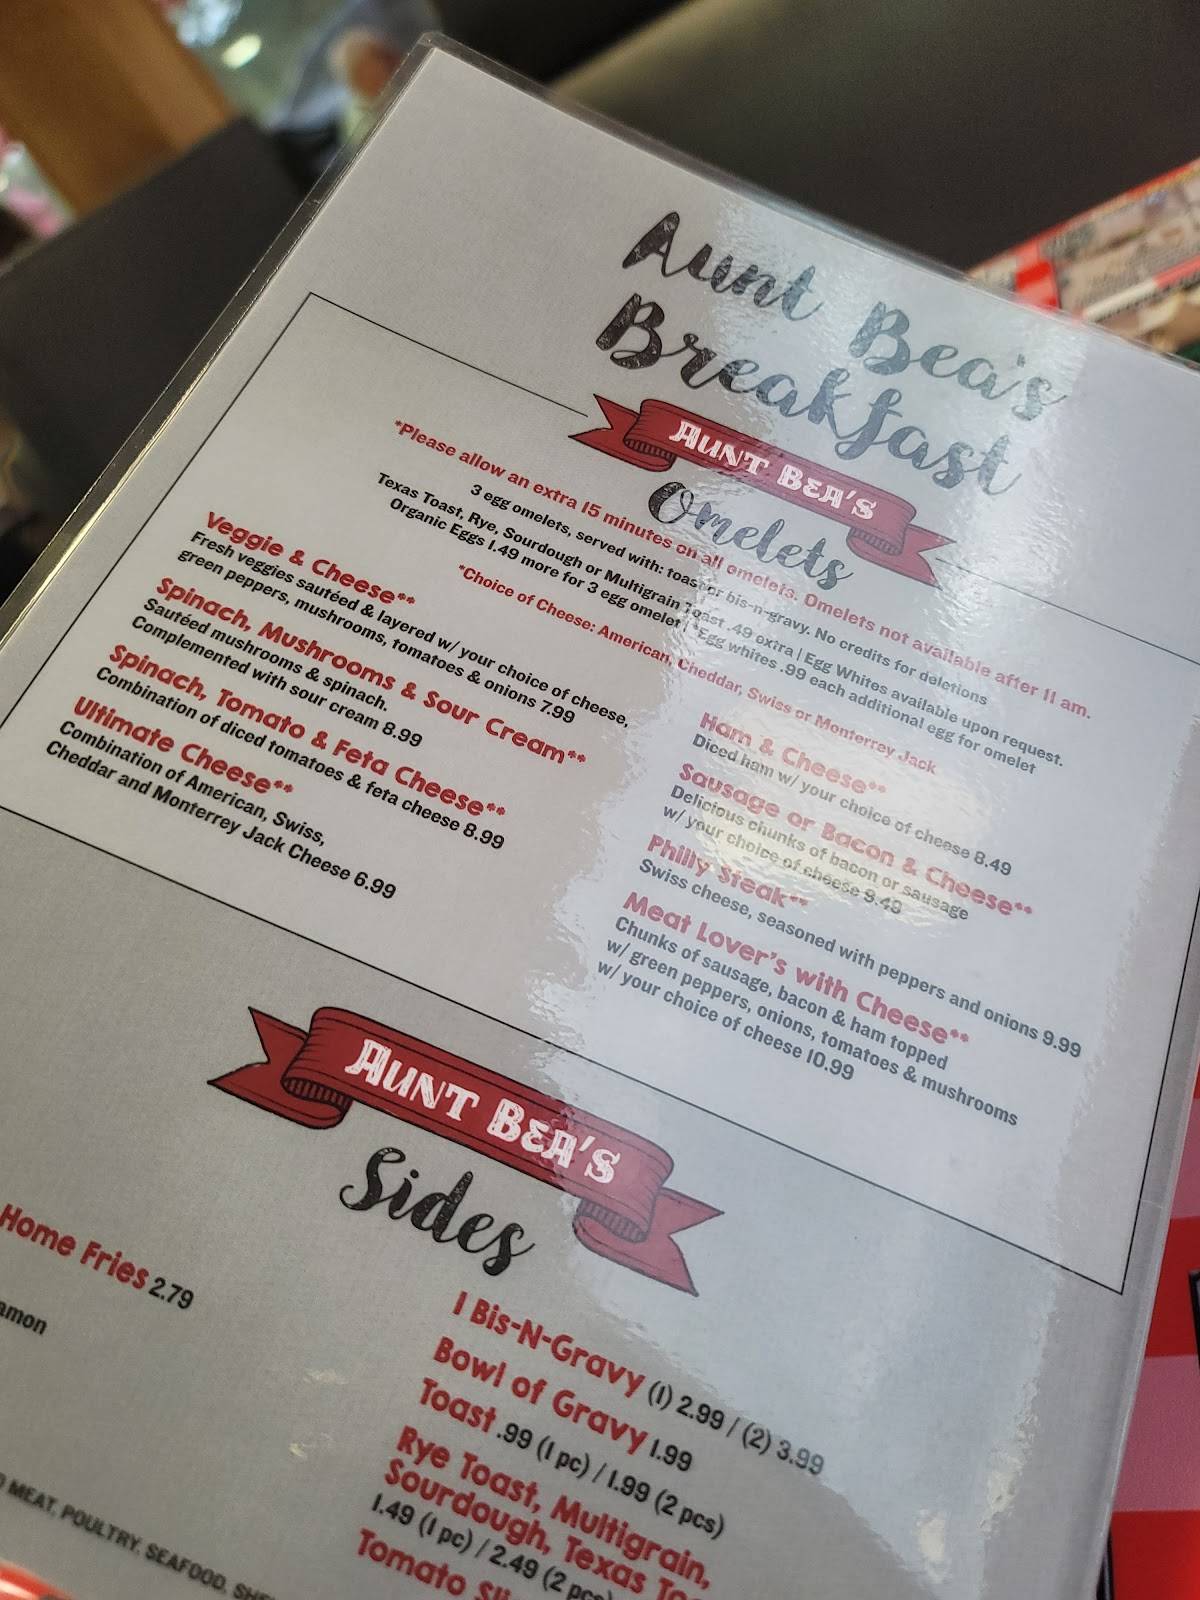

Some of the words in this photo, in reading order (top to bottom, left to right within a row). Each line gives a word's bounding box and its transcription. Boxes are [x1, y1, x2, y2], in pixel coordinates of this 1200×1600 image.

[622, 211, 825, 322] Aunt
[848, 301, 1067, 422] Bea's
[595, 293, 1023, 496] Breakfast
[668, 419, 770, 477] AUNT
[206, 511, 284, 557] Veggie
[458, 451, 506, 477] allow
[506, 472, 530, 489] an
[532, 483, 577, 510] extra
[602, 512, 673, 549] minutes
[803, 592, 876, 631] Omelets
[994, 672, 1038, 696] after
[469, 483, 483, 496] 3
[482, 492, 512, 511] egg
[511, 504, 571, 537] omelets,
[575, 531, 627, 558] served
[627, 552, 664, 574] with:
[647, 481, 853, 591] Omelets
[131, 615, 251, 674] Complemented
[251, 667, 287, 691] with
[288, 684, 328, 706] sour
[328, 701, 379, 730] cream
[381, 721, 423, 747] 8.99
[143, 597, 211, 634] Sautéed
[209, 628, 303, 674] mushrooms
[322, 676, 387, 712] spinach.
[155, 577, 251, 632] Spinach,
[256, 621, 396, 690] Mushrooms
[422, 690, 480, 725] Sour
[176, 549, 224, 575] green
[222, 569, 290, 605] peppers,
[293, 598, 387, 647] mushrooms,
[391, 638, 464, 677] tomatoes
[483, 679, 537, 708] onions
[539, 699, 575, 723] 7.99
[190, 530, 235, 558] Fresh
[237, 552, 295, 583] veggies
[295, 578, 360, 611] sautéed
[376, 609, 436, 643] layered
[457, 647, 496, 668] your
[497, 663, 549, 691] choice
[550, 686, 571, 700] of
[570, 695, 628, 728] cheese,
[377, 471, 419, 499] Texas
[422, 490, 464, 520] Toast,
[467, 511, 498, 535] Rye,
[502, 526, 583, 569] Sourdough
[584, 564, 603, 576] or
[603, 569, 681, 610] Multigrain
[1002, 734, 1063, 767] request.
[389, 497, 447, 530] Organic
[448, 522, 485, 546] Eggs
[487, 539, 520, 560] 1.49
[520, 555, 559, 577] more
[561, 571, 585, 588] for
[586, 581, 599, 594] 3
[599, 589, 629, 609] egg
[629, 602, 681, 628] omelet
[808, 676, 846, 697] each
[847, 691, 925, 729] additional
[926, 723, 956, 744] egg
[957, 733, 981, 751] for
[516, 592, 536, 605] of
[535, 598, 596, 632] Cheese:
[746, 686, 792, 714] Swiss
[73, 695, 174, 753] Ultimate
[96, 666, 198, 719] Combination
[199, 713, 221, 728] of
[219, 720, 268, 748] diced
[267, 739, 344, 781] tomatoes
[364, 780, 399, 806] feta
[401, 799, 460, 831] cheese
[462, 822, 505, 849] 8.99
[108, 644, 207, 701] Spinach,
[216, 687, 305, 739] Tomato
[331, 738, 390, 776] Feta
[699, 711, 752, 747] Ham
[45, 740, 118, 779] Cheddar
[117, 774, 153, 795] and
[151, 784, 241, 835] Monterrey
[241, 825, 286, 853] Jack
[287, 843, 351, 880] Cheese
[353, 871, 396, 899] 6.99
[59, 720, 163, 775] Combination
[164, 768, 187, 783] of
[183, 774, 267, 822] American,
[272, 811, 324, 847] Swiss,
[678, 762, 780, 818] Sausage
[820, 821, 895, 867] Bacon
[646, 833, 712, 878] Philly
[615, 916, 678, 954] Chunks
[680, 947, 701, 963] of
[701, 956, 772, 997] sausage,
[776, 984, 828, 1019] bacon
[849, 1015, 886, 1044] ham
[889, 1034, 949, 1070] topped
[622, 891, 692, 934] Meat
[795, 966, 849, 1003] with
[638, 858, 688, 889] Swiss
[690, 883, 752, 920] cheese,
[756, 911, 837, 953] seasoned
[839, 945, 875, 970] with
[877, 963, 946, 1000] peppers
[948, 993, 981, 1015] and
[983, 1008, 1039, 1040] onions
[1041, 1029, 1082, 1058] 9.99
[619, 971, 661, 996] your
[662, 990, 718, 1022] choice
[721, 1015, 742, 1032] of
[742, 1024, 803, 1058] cheese
[628, 951, 678, 980] green
[679, 972, 751, 1013] peppers,
[756, 1005, 815, 1041] onions,
[820, 1030, 899, 1075] tomatoes
[921, 1075, 1018, 1126] mushrooms
[345, 1039, 480, 1122] AUNT
[0, 1203, 76, 1257] Home
[79, 1240, 149, 1290] Fries
[147, 1276, 194, 1310] 2.79
[339, 1147, 535, 1277] Sides
[419, 1377, 497, 1433] Toast
[606, 1469, 651, 1503] 1.99
[432, 1336, 507, 1388] Bowl
[511, 1376, 548, 1405] of
[552, 1389, 648, 1455] Gravy
[649, 1438, 693, 1472] 1.99
[469, 1298, 646, 1398] Bis-N-Gravy
[647, 1380, 673, 1411] (1)
[675, 1395, 725, 1430] 2.99
[741, 1421, 772, 1456] (2)
[776, 1439, 824, 1476] 3.99
[357, 1528, 466, 1596] Tomato
[371, 1493, 415, 1526] 1.49
[488, 1544, 539, 1580] 2.49
[384, 1458, 551, 1555] Sourdough,
[564, 1535, 647, 1594] Texas
[396, 1425, 450, 1469] Rye
[460, 1451, 541, 1514] Toast,
[549, 1495, 710, 1590] Multigrain,
